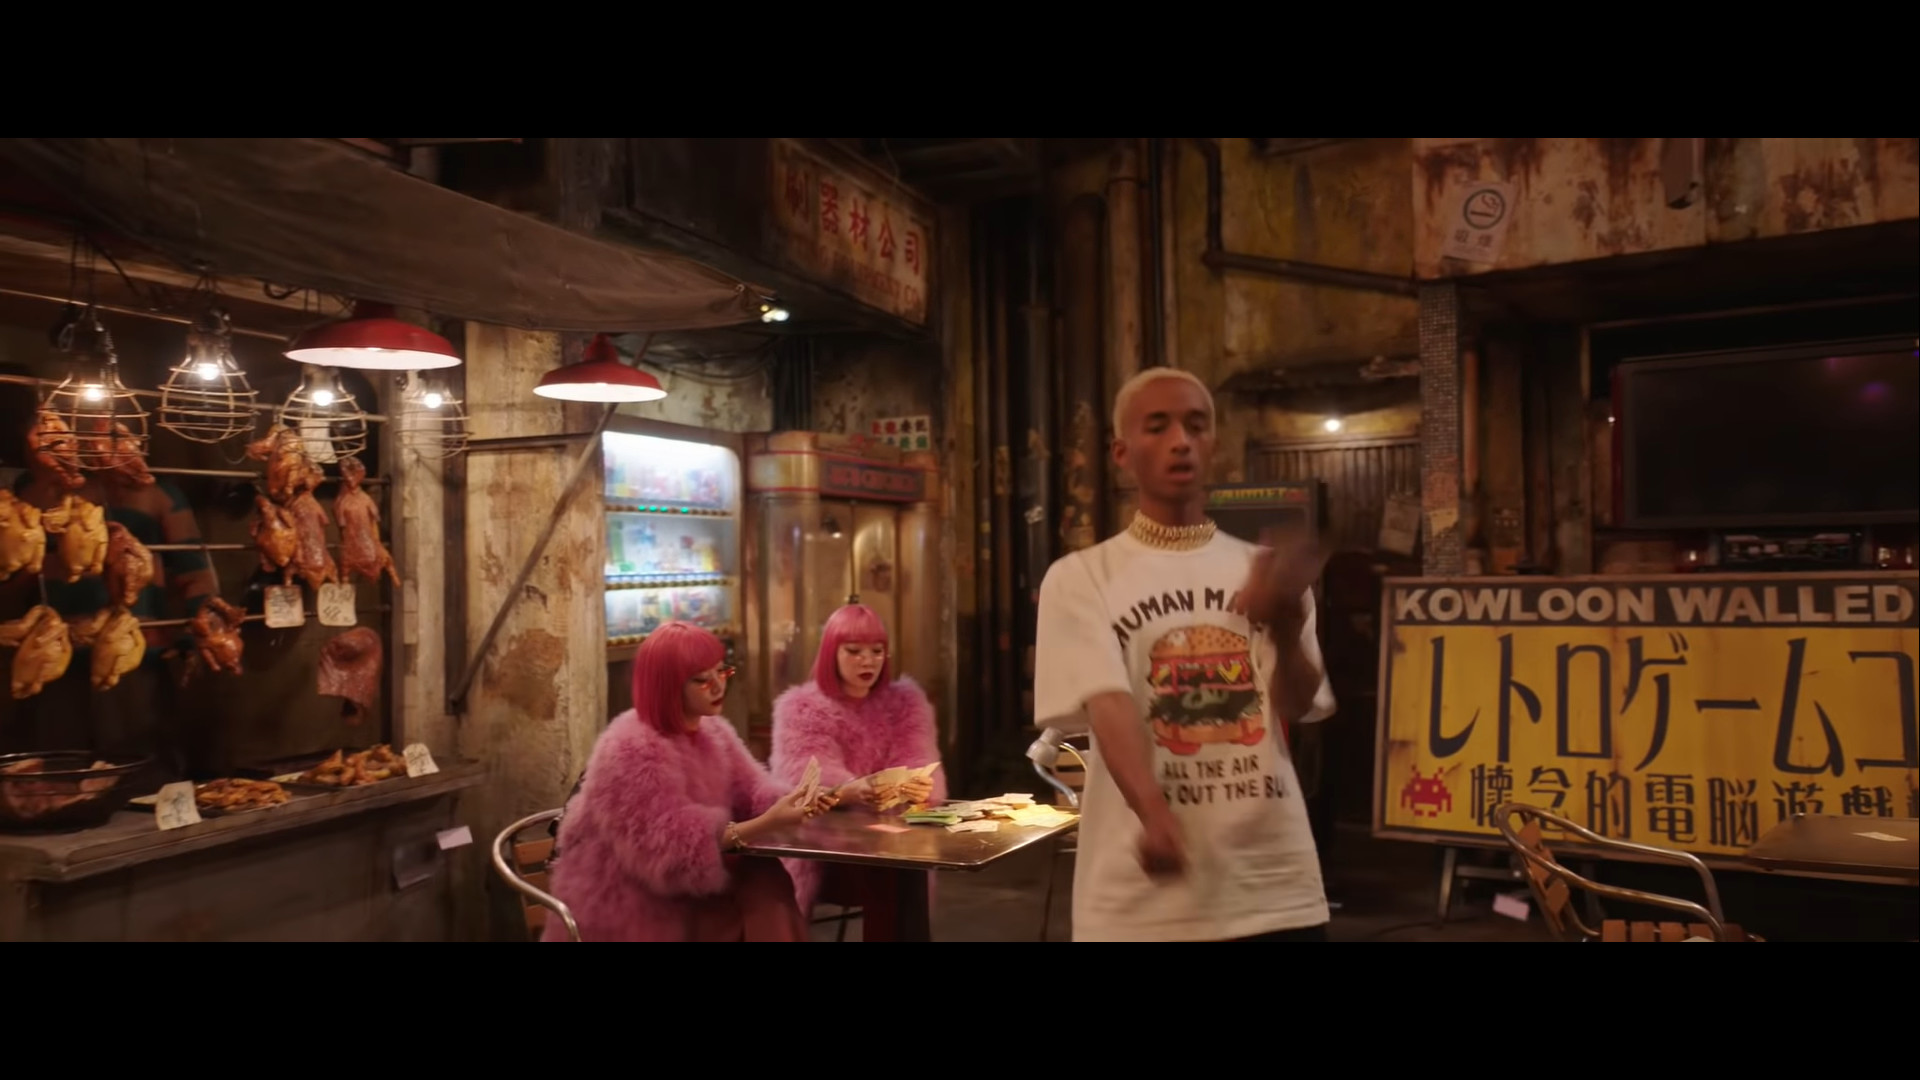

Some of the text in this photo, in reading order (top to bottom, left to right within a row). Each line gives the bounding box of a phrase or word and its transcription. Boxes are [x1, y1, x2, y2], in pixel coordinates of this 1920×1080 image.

[1396, 586, 1914, 622] KOWLOON WALLED
[1428, 631, 1919, 777] レトロゲームコ
[1196, 760, 1225, 778] THE
[1231, 755, 1259, 775] AIR
[1178, 784, 1216, 805] OUT
[1223, 779, 1259, 801] THE
